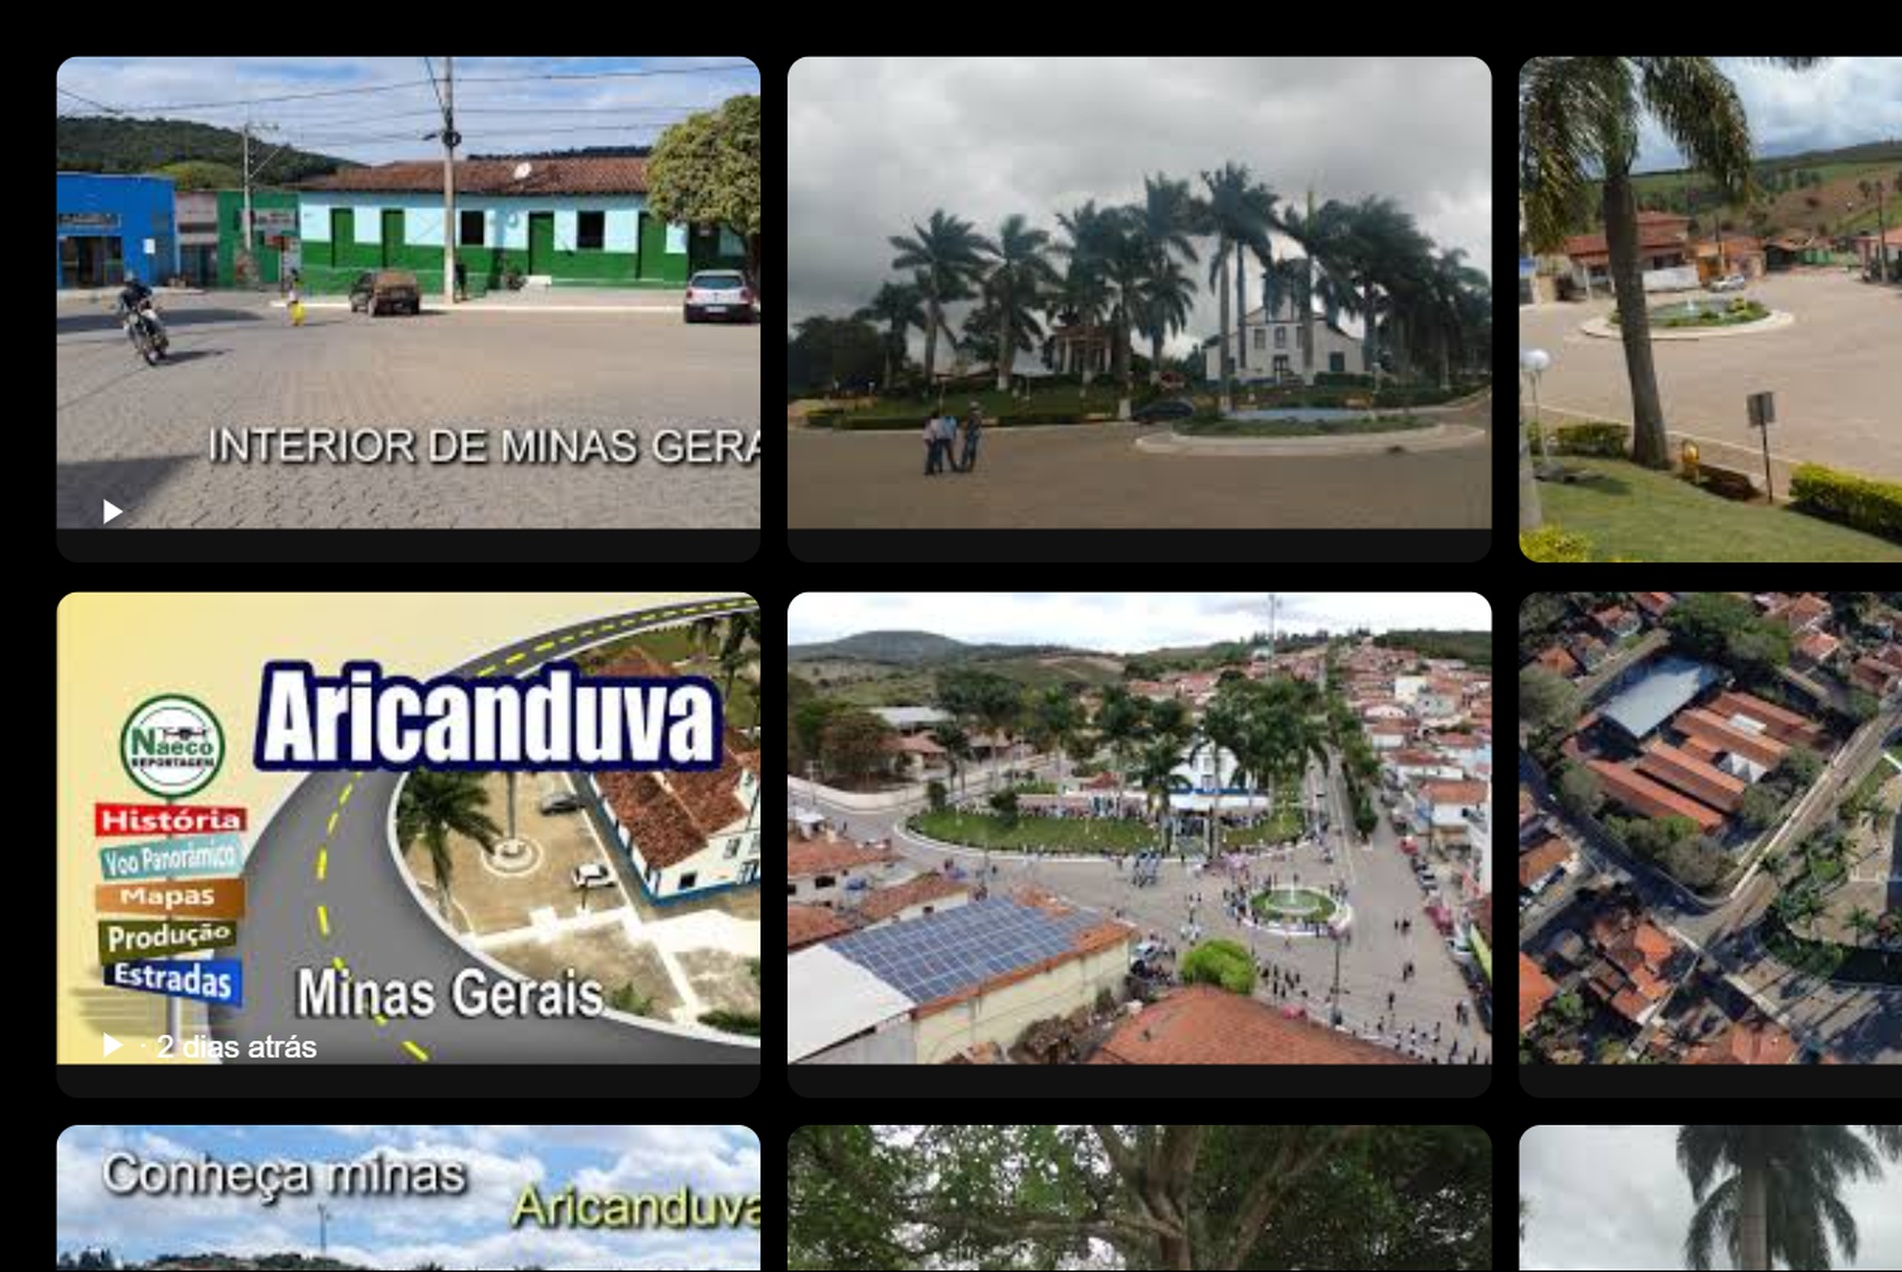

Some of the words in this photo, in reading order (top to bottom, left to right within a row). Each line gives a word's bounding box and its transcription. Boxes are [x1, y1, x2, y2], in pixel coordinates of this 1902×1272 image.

[131, 727, 215, 756] Naeco
[101, 808, 241, 832] História
[104, 850, 139, 877] Voo
[141, 839, 236, 871] Panorâmico
[119, 886, 216, 911] Mapas
[107, 922, 232, 953] Produção
[113, 961, 233, 999] Estradas
